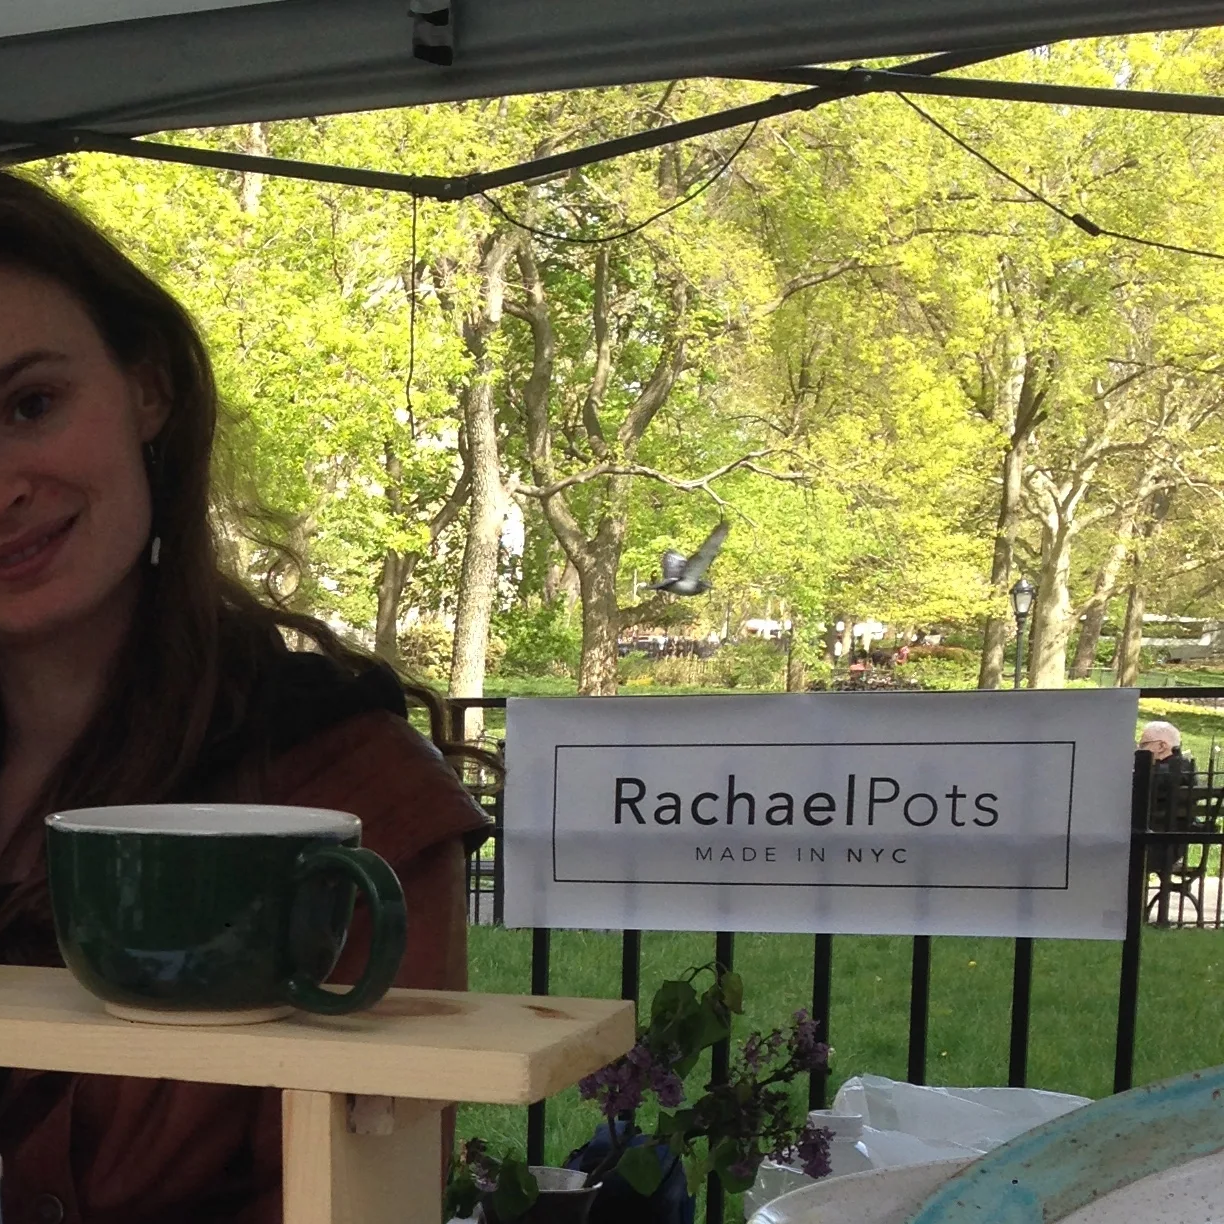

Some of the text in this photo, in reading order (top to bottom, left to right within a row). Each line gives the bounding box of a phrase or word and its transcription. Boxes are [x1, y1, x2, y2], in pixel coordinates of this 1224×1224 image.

[614, 774, 999, 827] RachaelPots
[695, 847, 907, 864] MADE IN NYC
